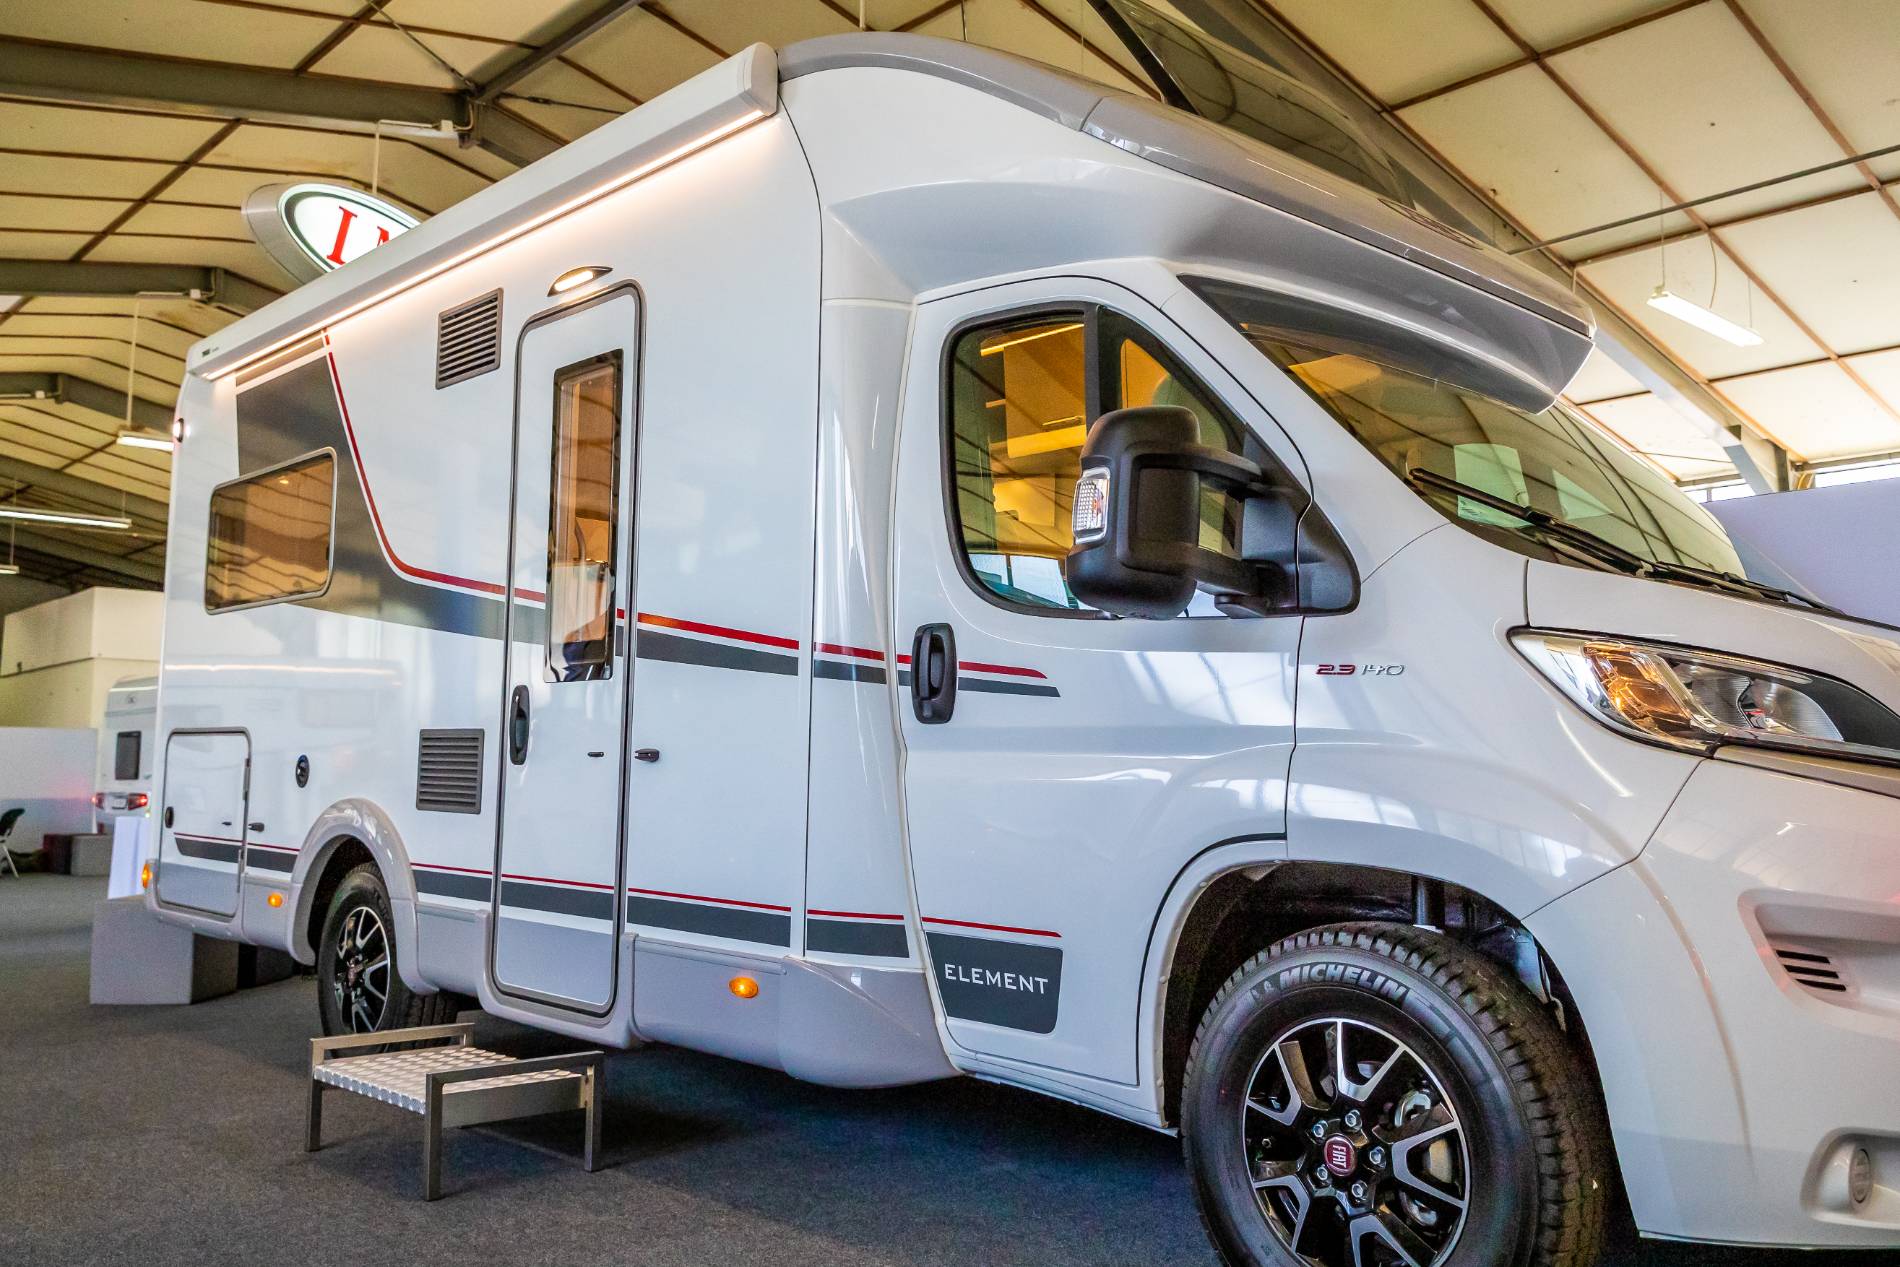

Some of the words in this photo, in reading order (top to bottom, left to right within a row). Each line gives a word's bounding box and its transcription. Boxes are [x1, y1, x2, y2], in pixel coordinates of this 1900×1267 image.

[1316, 664, 1356, 675] 2.3
[1361, 664, 1405, 676] 140
[944, 963, 1049, 994] ELEMENT
[1279, 963, 1407, 1001] MICHELIN
[1332, 1144, 1347, 1169] FIAT
